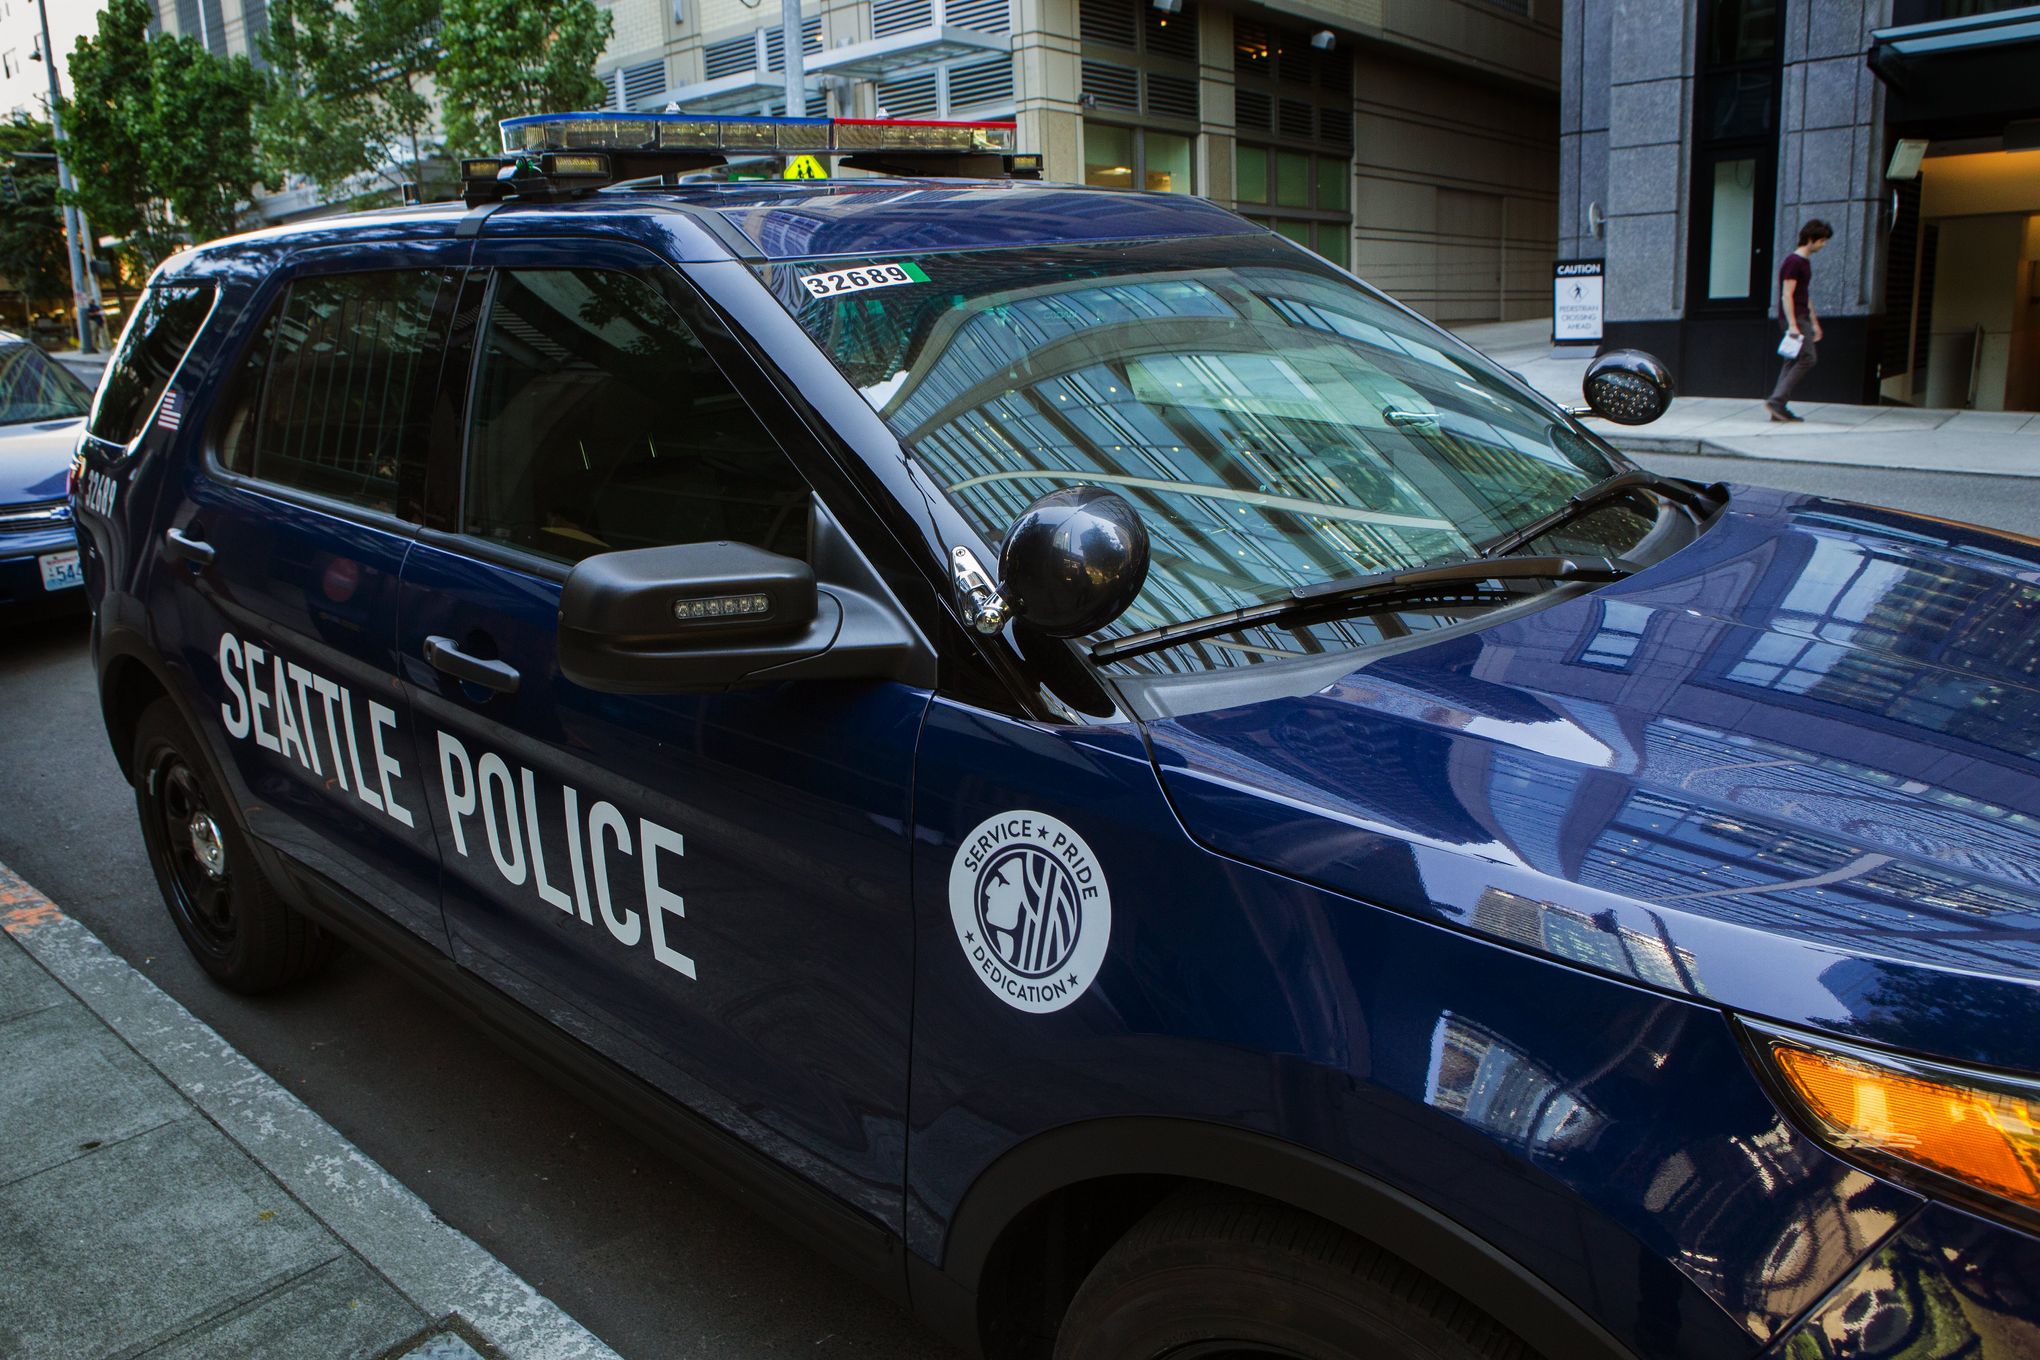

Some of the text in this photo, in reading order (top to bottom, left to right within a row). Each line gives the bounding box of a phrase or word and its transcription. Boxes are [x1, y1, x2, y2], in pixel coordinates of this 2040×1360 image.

[807, 266, 908, 295] 32689
[1557, 264, 1601, 275] CAUTION
[1561, 314, 1597, 322] CROSSING
[85, 469, 117, 519] 32689
[219, 632, 698, 982] SEATTLE POLICE
[964, 819, 1098, 901] SERVICE PRIDE
[972, 945, 1067, 1003] DEDICATION
